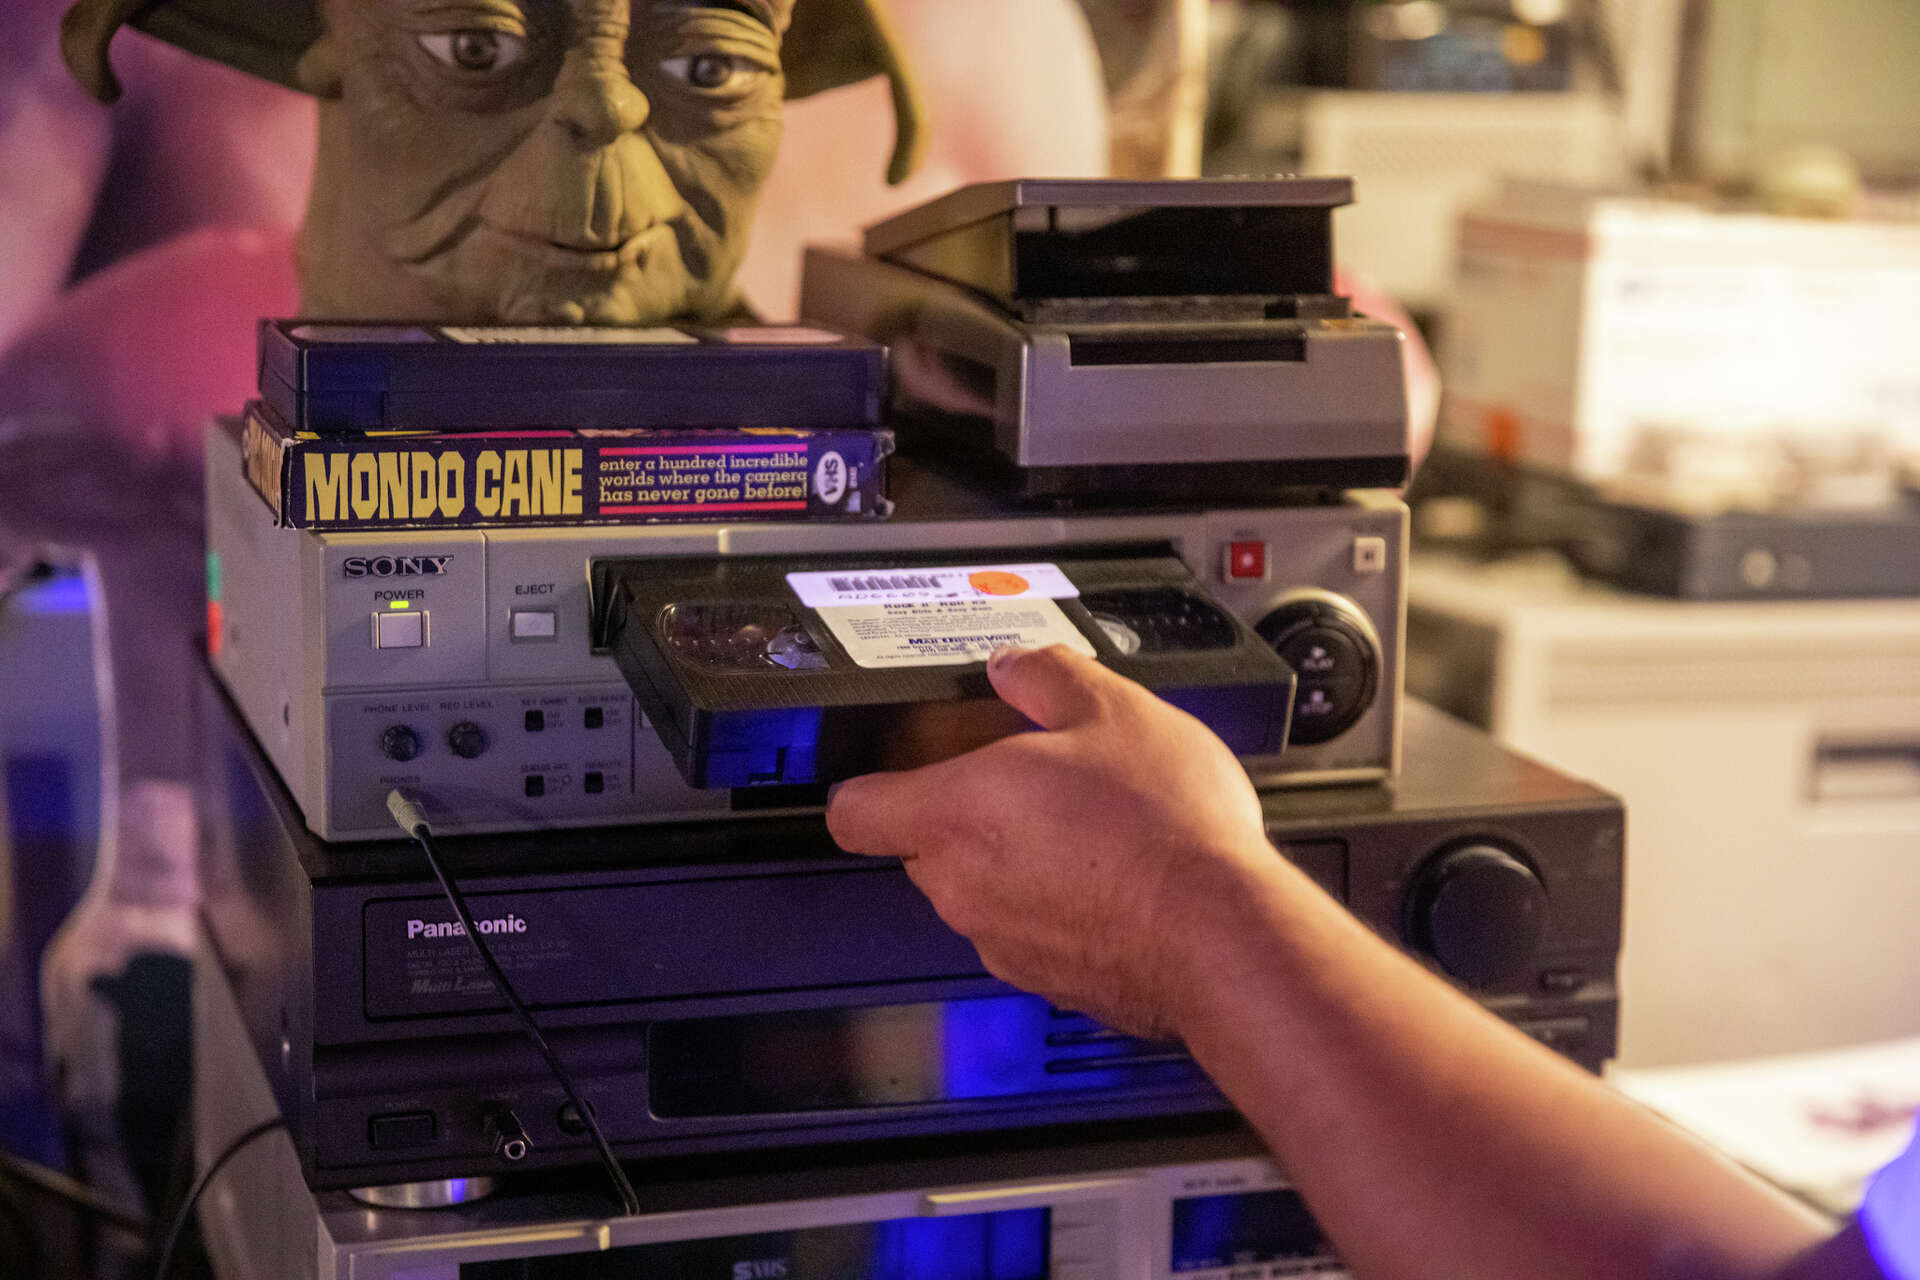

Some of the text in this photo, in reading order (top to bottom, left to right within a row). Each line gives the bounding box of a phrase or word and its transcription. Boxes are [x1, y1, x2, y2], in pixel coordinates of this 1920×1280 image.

[600, 453, 807, 472] enter a hundred incredible
[304, 451, 465, 521] MONDO
[475, 449, 583, 517] CANE
[599, 469, 807, 487] worlds where the camera
[824, 457, 839, 496] VHS
[599, 483, 807, 503] has never gone before!
[344, 555, 454, 577] SONY
[374, 589, 425, 601] POWER
[515, 584, 555, 595] EJECT
